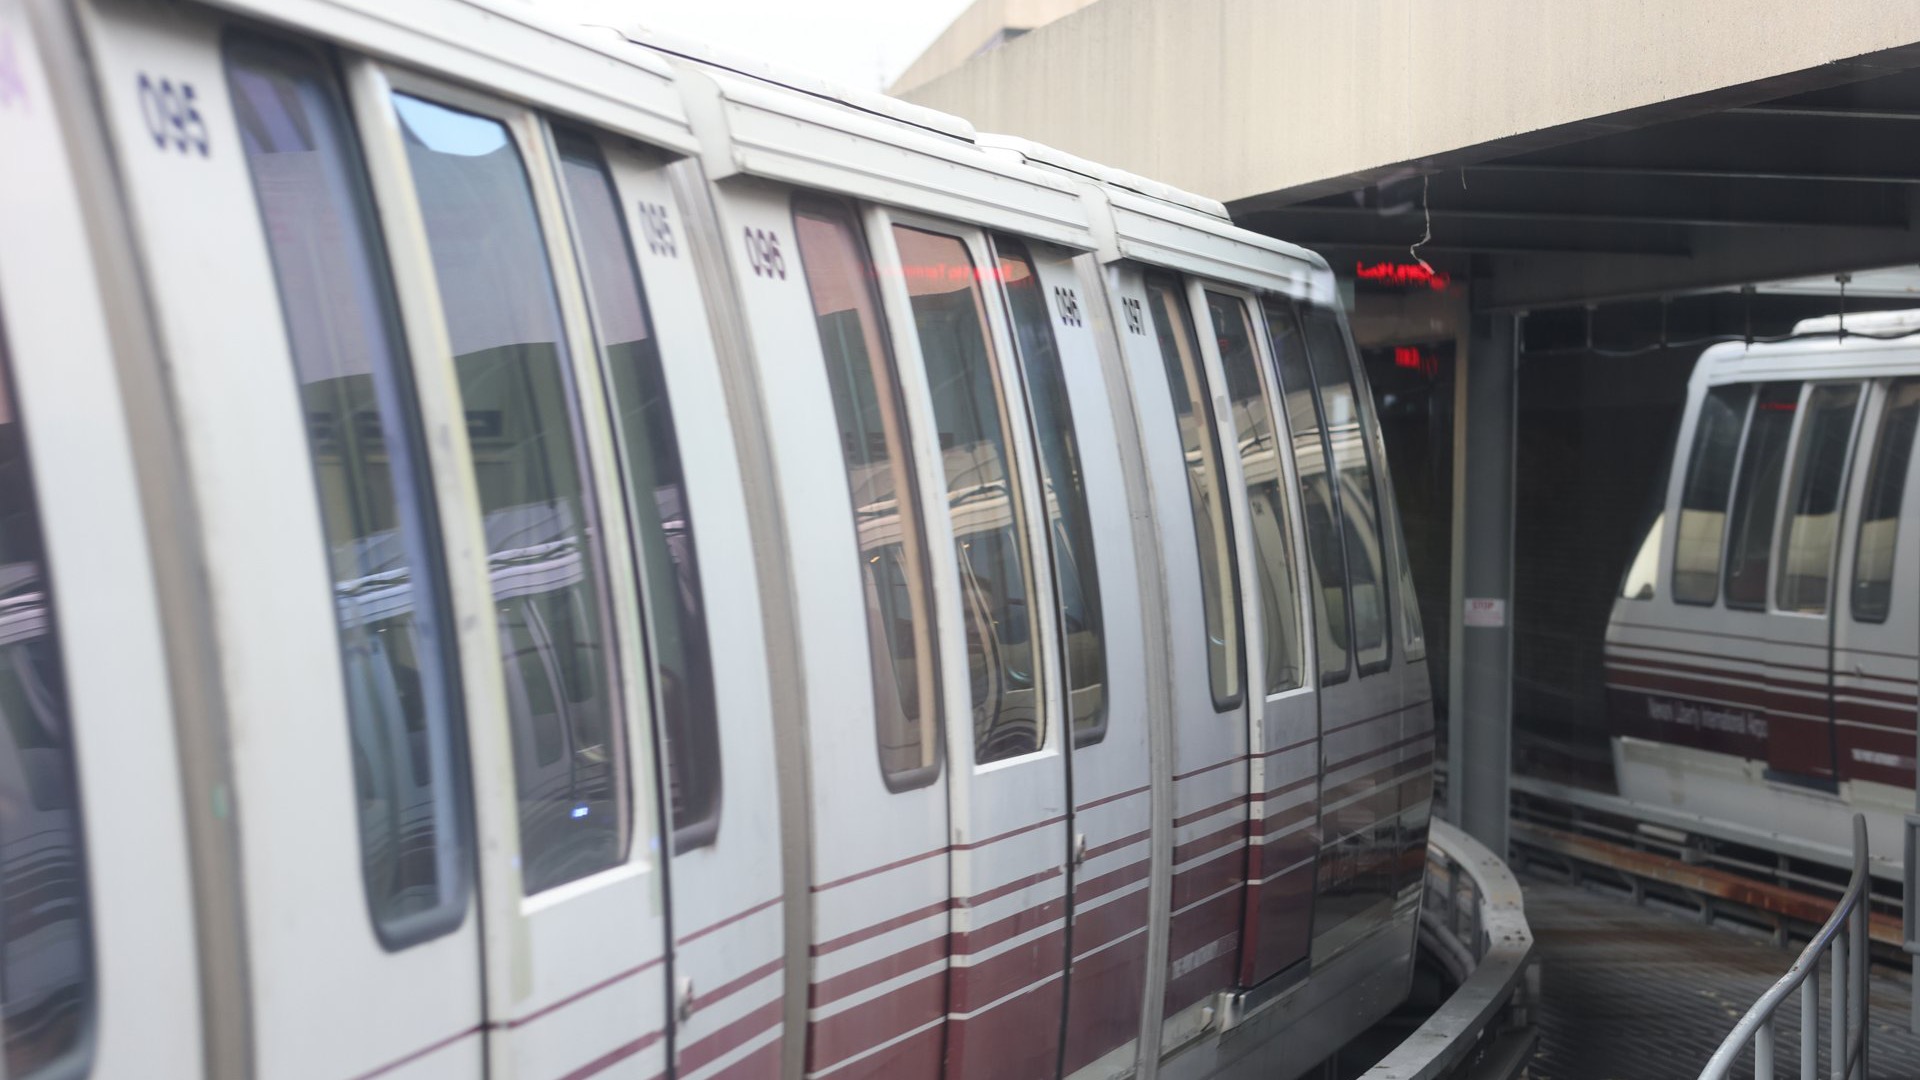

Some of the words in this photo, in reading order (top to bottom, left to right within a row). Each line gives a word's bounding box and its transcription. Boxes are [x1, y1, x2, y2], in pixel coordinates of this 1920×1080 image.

[136, 70, 209, 158] 095
[637, 201, 678, 259] 095
[743, 225, 787, 281] 096
[1054, 286, 1082, 328] 096
[1122, 296, 1146, 336] 097
